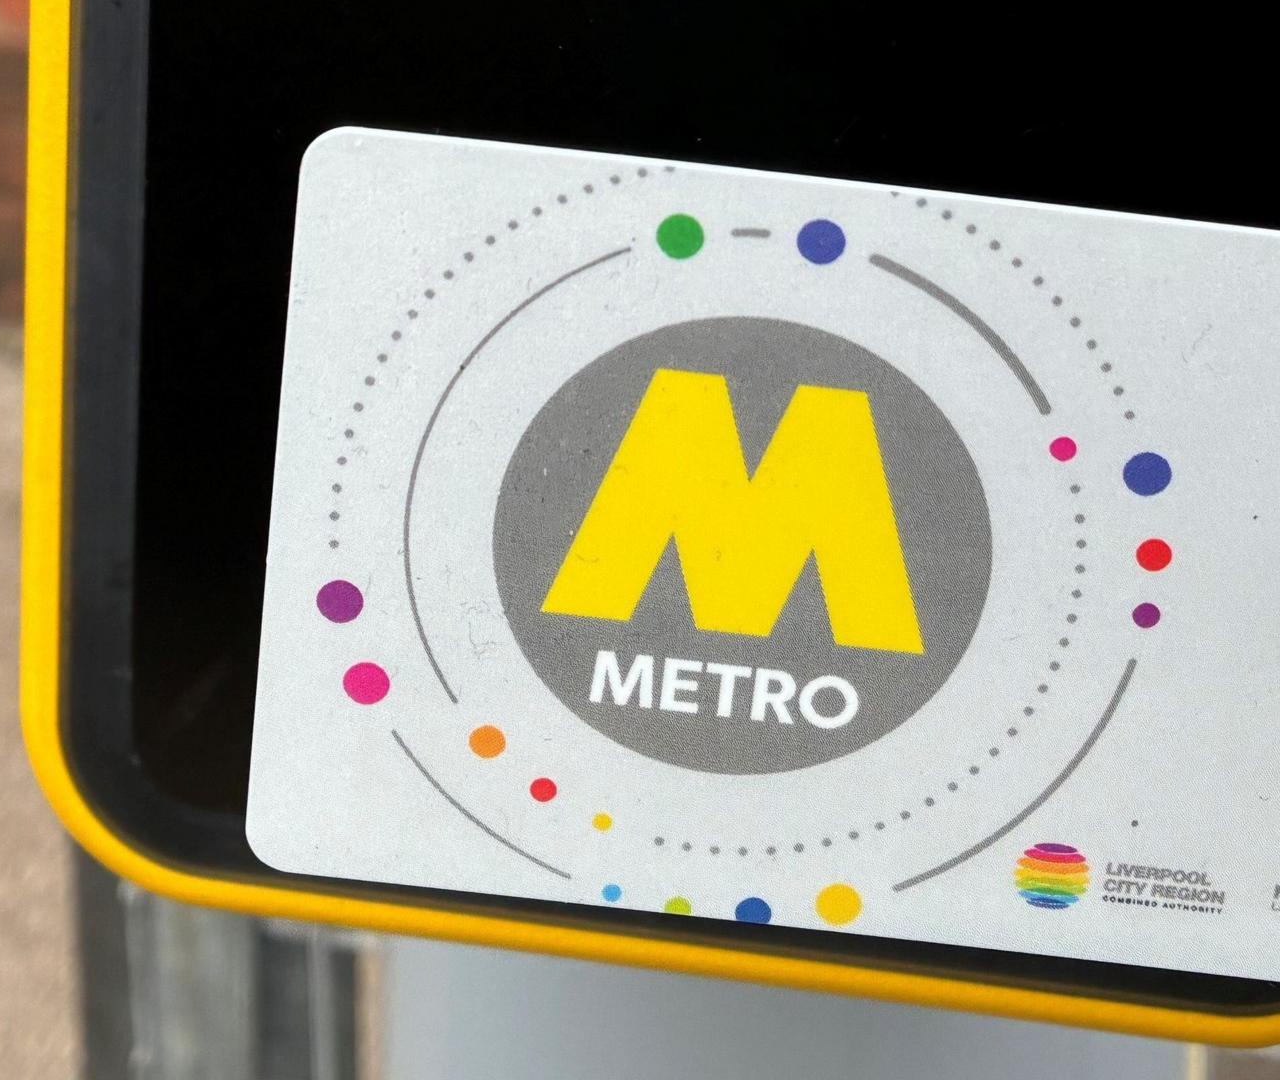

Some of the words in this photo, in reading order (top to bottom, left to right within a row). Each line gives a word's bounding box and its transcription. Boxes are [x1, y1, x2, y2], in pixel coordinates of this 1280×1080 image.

[589, 650, 859, 730] METRO
[1106, 862, 1212, 887] LIVERPOOL
[1103, 879, 1147, 895] CITY
[1150, 884, 1226, 905] REGION
[1102, 895, 1158, 908] COMBINED
[1161, 902, 1223, 915] AUTHORITY
